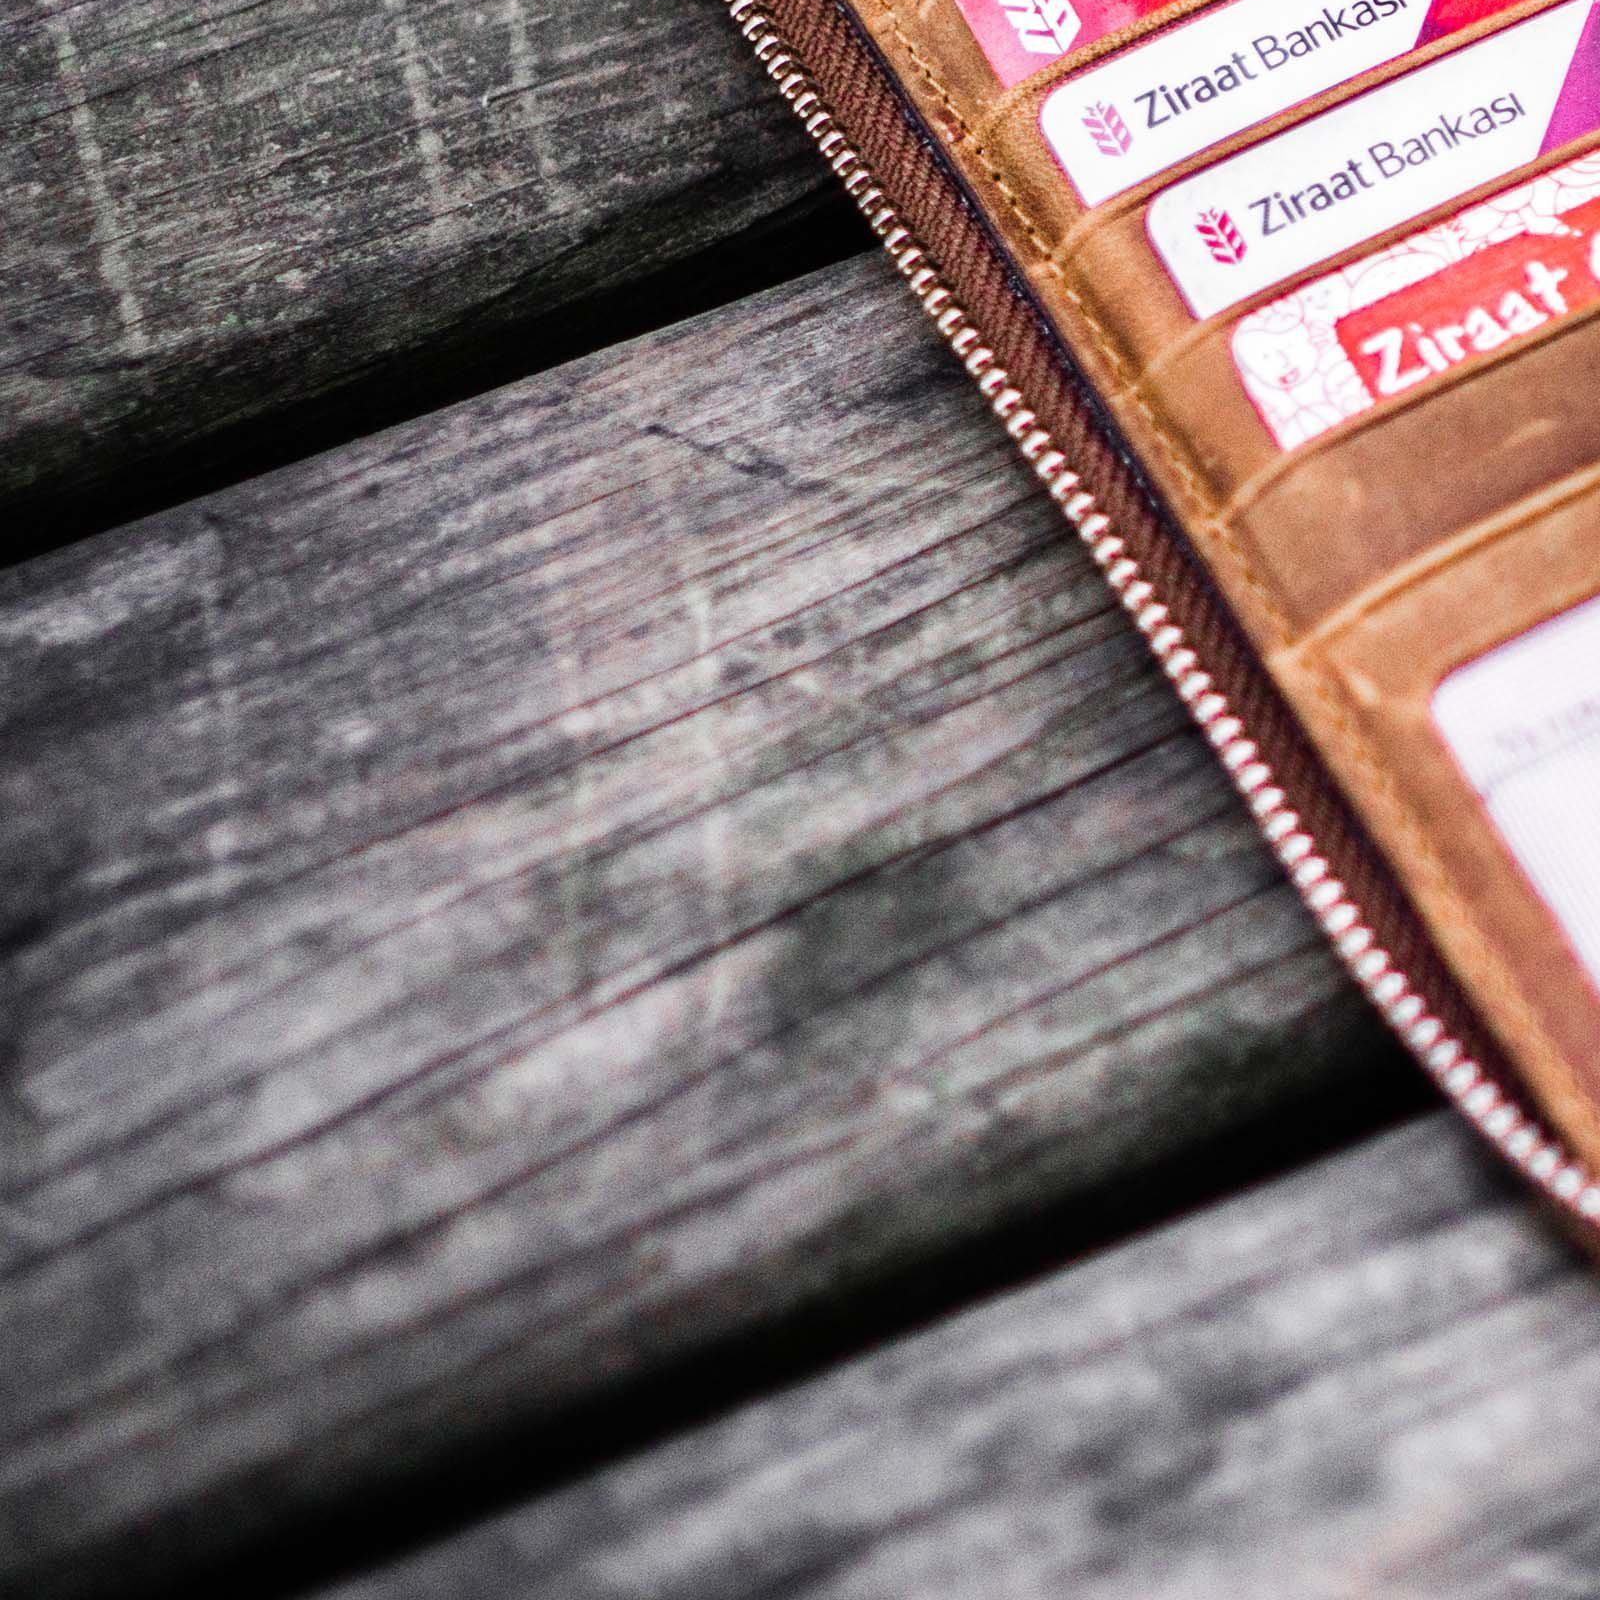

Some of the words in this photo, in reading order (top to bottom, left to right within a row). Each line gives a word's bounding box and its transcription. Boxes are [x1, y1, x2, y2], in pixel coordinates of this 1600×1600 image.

[1133, 51, 1258, 129] Ziraat
[1247, 158, 1375, 237] Ziraat
[1358, 259, 1569, 395] Ziraat
